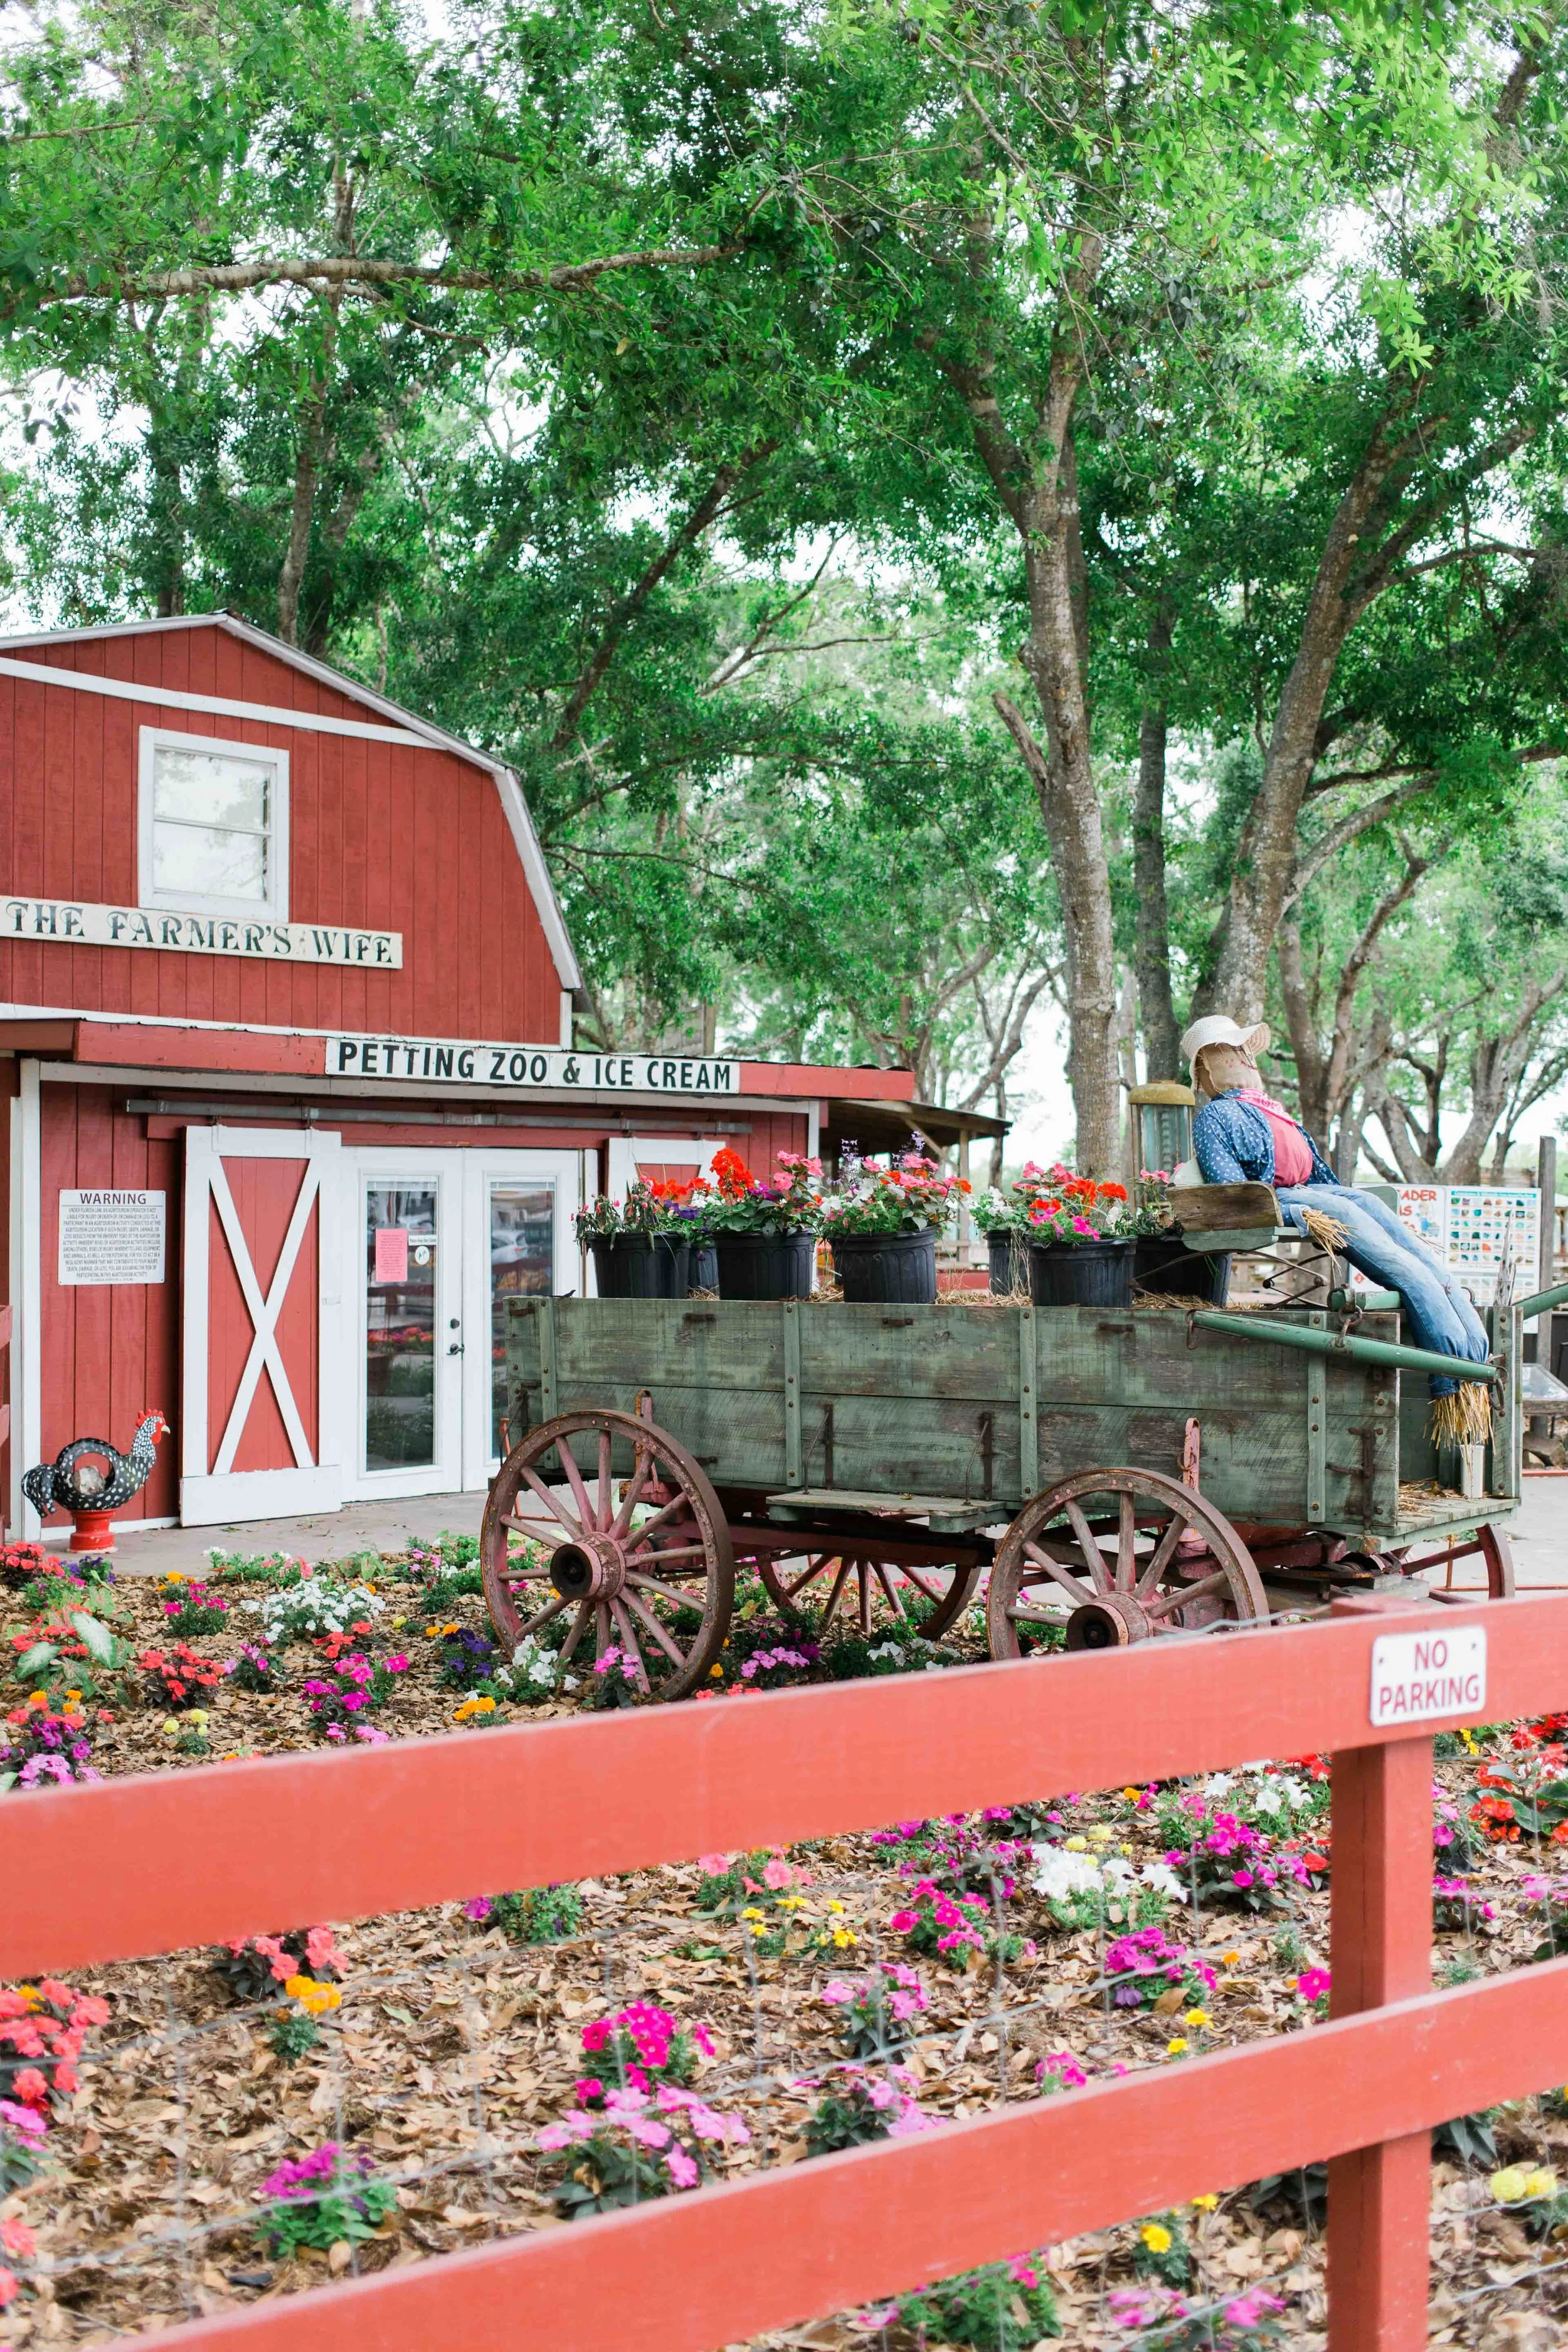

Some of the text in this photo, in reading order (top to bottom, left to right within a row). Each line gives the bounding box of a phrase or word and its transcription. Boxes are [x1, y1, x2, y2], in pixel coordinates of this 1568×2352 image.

[6, 901, 393, 963] THE FARMER'S WIFE
[339, 1042, 731, 1090] PETTING ZOO & ICE CREAM
[80, 1193, 147, 1205] WARNING
[1397, 1189, 1437, 1201] ADER
[1414, 1640, 1448, 1671] NO
[1379, 1674, 1480, 1717] PARKING
